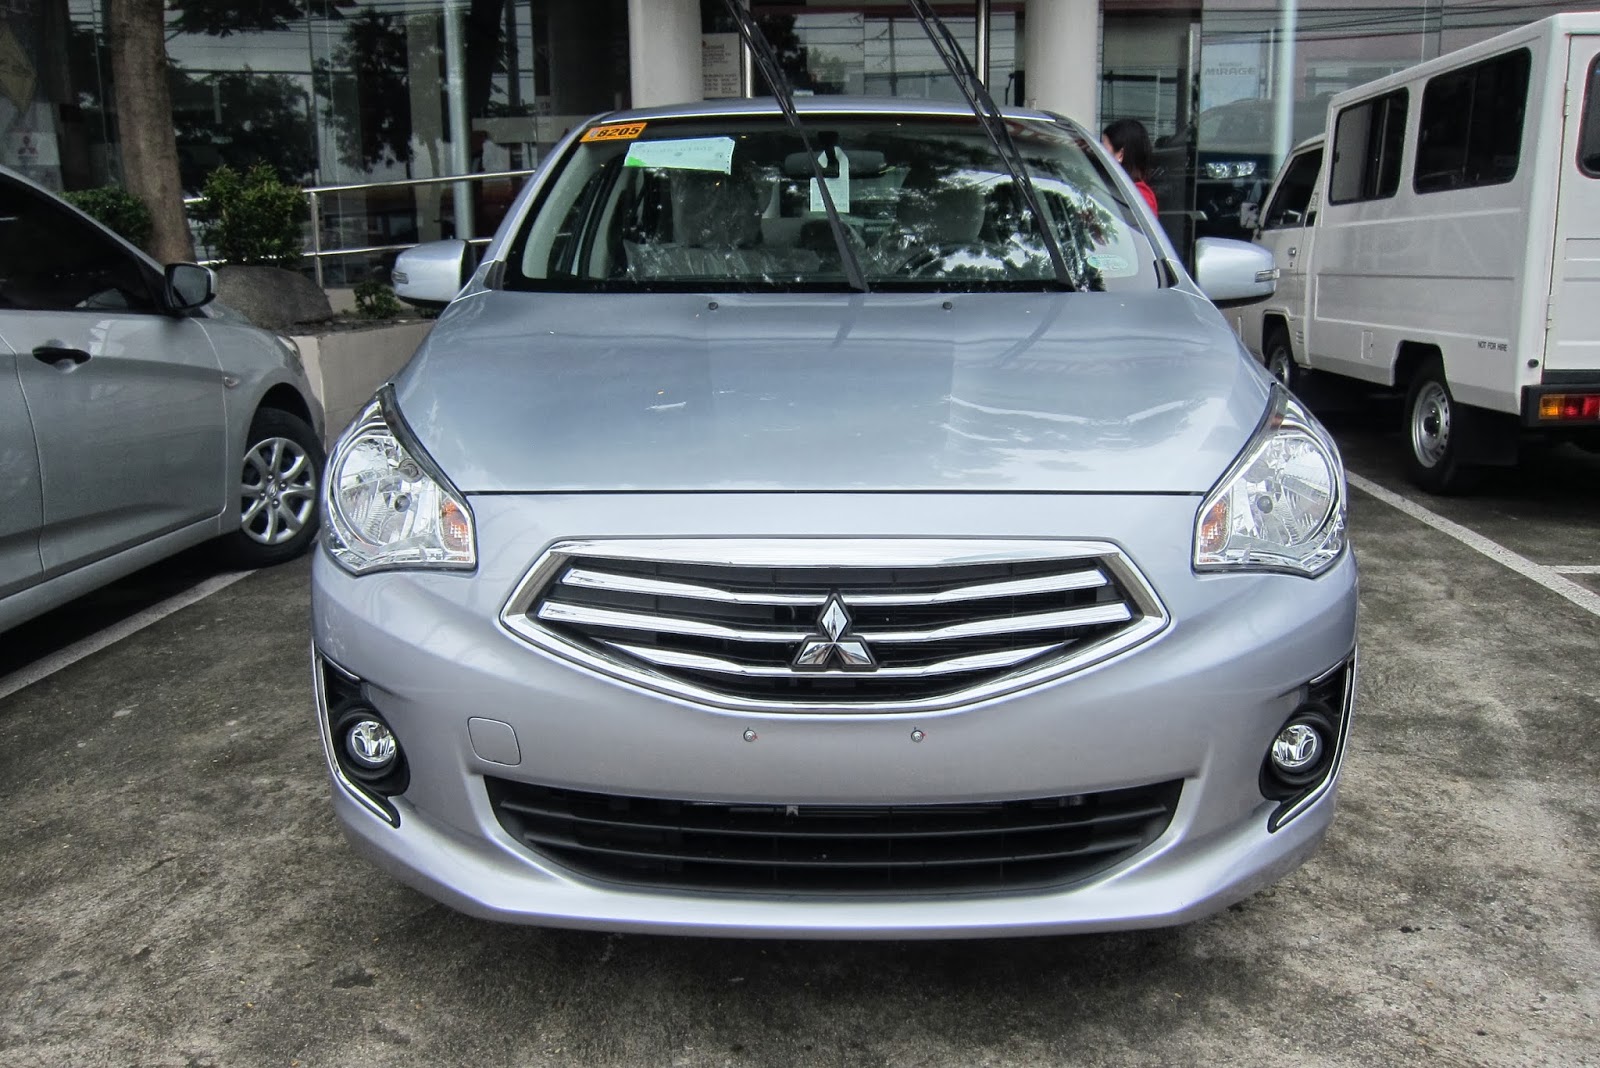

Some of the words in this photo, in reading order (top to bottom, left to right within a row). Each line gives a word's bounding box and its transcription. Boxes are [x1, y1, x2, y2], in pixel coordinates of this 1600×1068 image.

[1205, 67, 1256, 76] MIRAGE
[597, 127, 642, 137] 8205
[1477, 341, 1487, 349] NOT
[1487, 342, 1497, 351] FOR
[1497, 344, 1508, 352] HIRE
